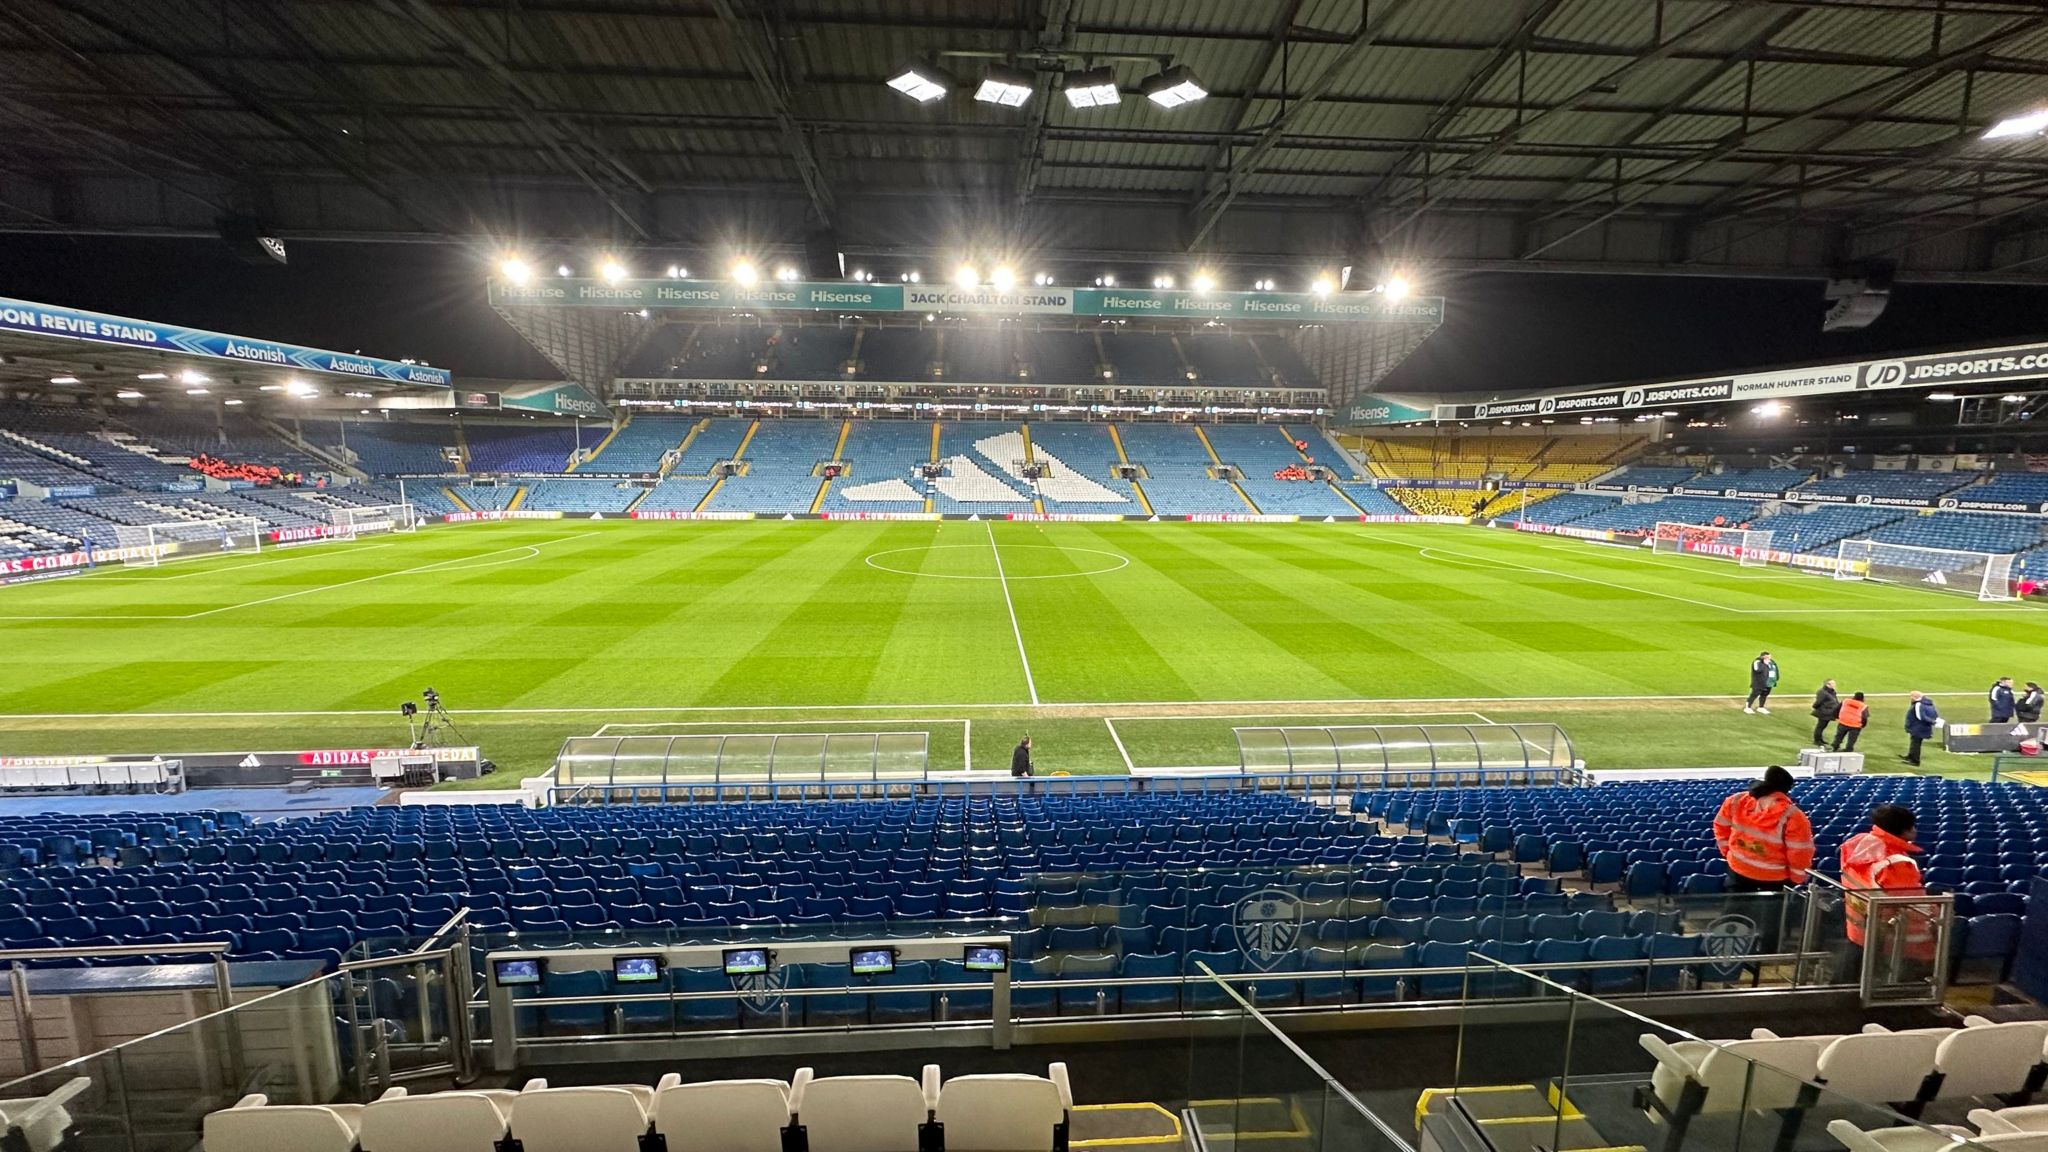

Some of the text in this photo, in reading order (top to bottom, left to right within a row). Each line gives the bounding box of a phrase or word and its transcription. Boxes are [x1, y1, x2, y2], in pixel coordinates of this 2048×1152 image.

[499, 285, 566, 298] Hisense
[579, 286, 643, 299] Hisense
[656, 288, 720, 301] Hisense
[733, 288, 797, 302] Hisense
[810, 289, 872, 304] Hisense
[910, 293, 1067, 306] JACK CHARLTON STAND
[1103, 296, 1162, 310] Hisense
[1174, 297, 1232, 311] Hisense
[1243, 299, 1301, 313] Hisense
[1313, 301, 1370, 314] Hisense
[1382, 302, 1438, 316] Hisense
[40, 315, 98, 337] REVIE
[100, 324, 158, 345] STAND
[224, 340, 287, 365] Astonish
[329, 356, 376, 378] Astonish
[1909, 353, 2048, 379] JDSPORTS.CO
[408, 367, 446, 386] Astonish
[1736, 373, 1852, 392] NORMAN HUNTER STAND
[1645, 383, 1729, 403] JDSPORTS.COM
[554, 392, 597, 413] Hisense
[1488, 402, 1536, 415] JDSPORTS.COM
[1556, 395, 1619, 410] JDSPORTS.COM
[1350, 404, 1391, 421] Hisense
[1872, 497, 1929, 506] JDSPORTS.COM
[1958, 501, 2027, 512] JDSPORTS.COM
